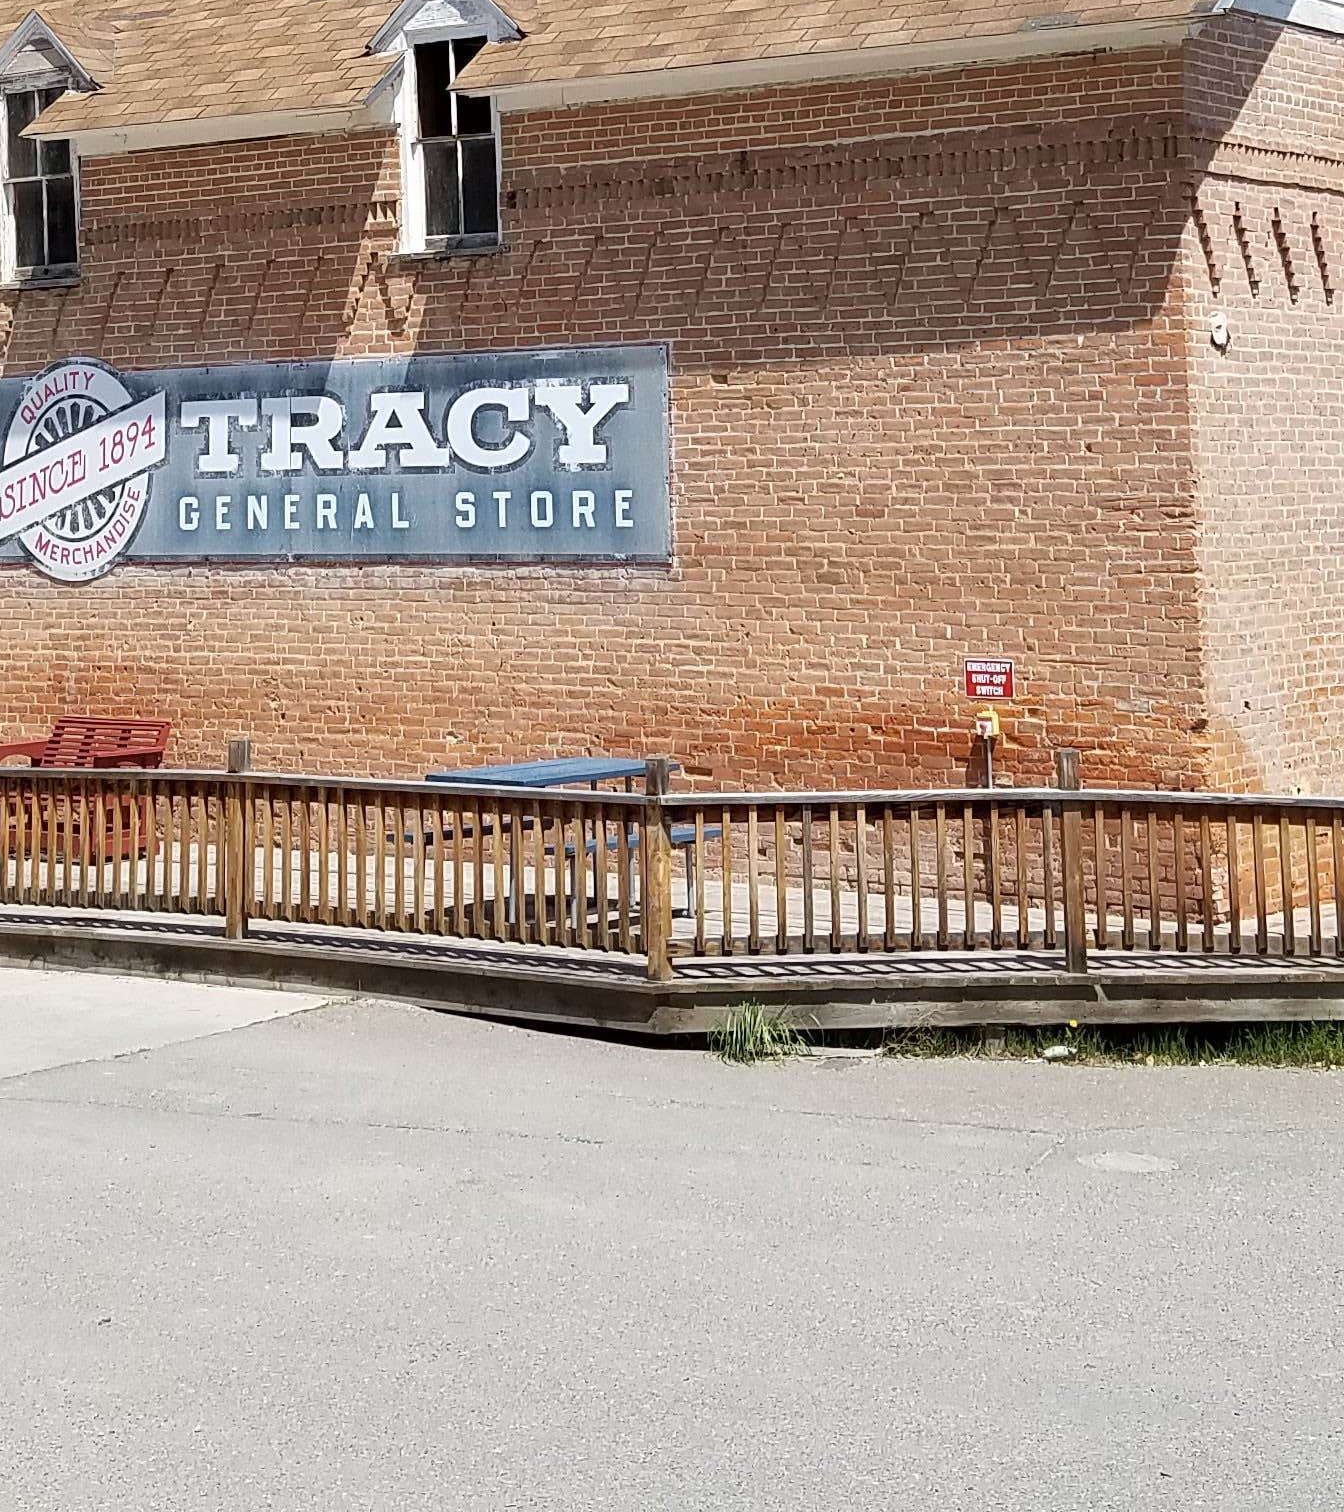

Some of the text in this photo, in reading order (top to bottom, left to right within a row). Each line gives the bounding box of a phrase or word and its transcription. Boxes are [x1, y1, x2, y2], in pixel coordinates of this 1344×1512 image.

[20, 371, 95, 425] QUALITY
[180, 383, 631, 473] TRACY
[0, 414, 156, 521] SINCE 1894
[34, 486, 141, 566] MERCHANDISE
[179, 489, 634, 531] GENERAL STORE
